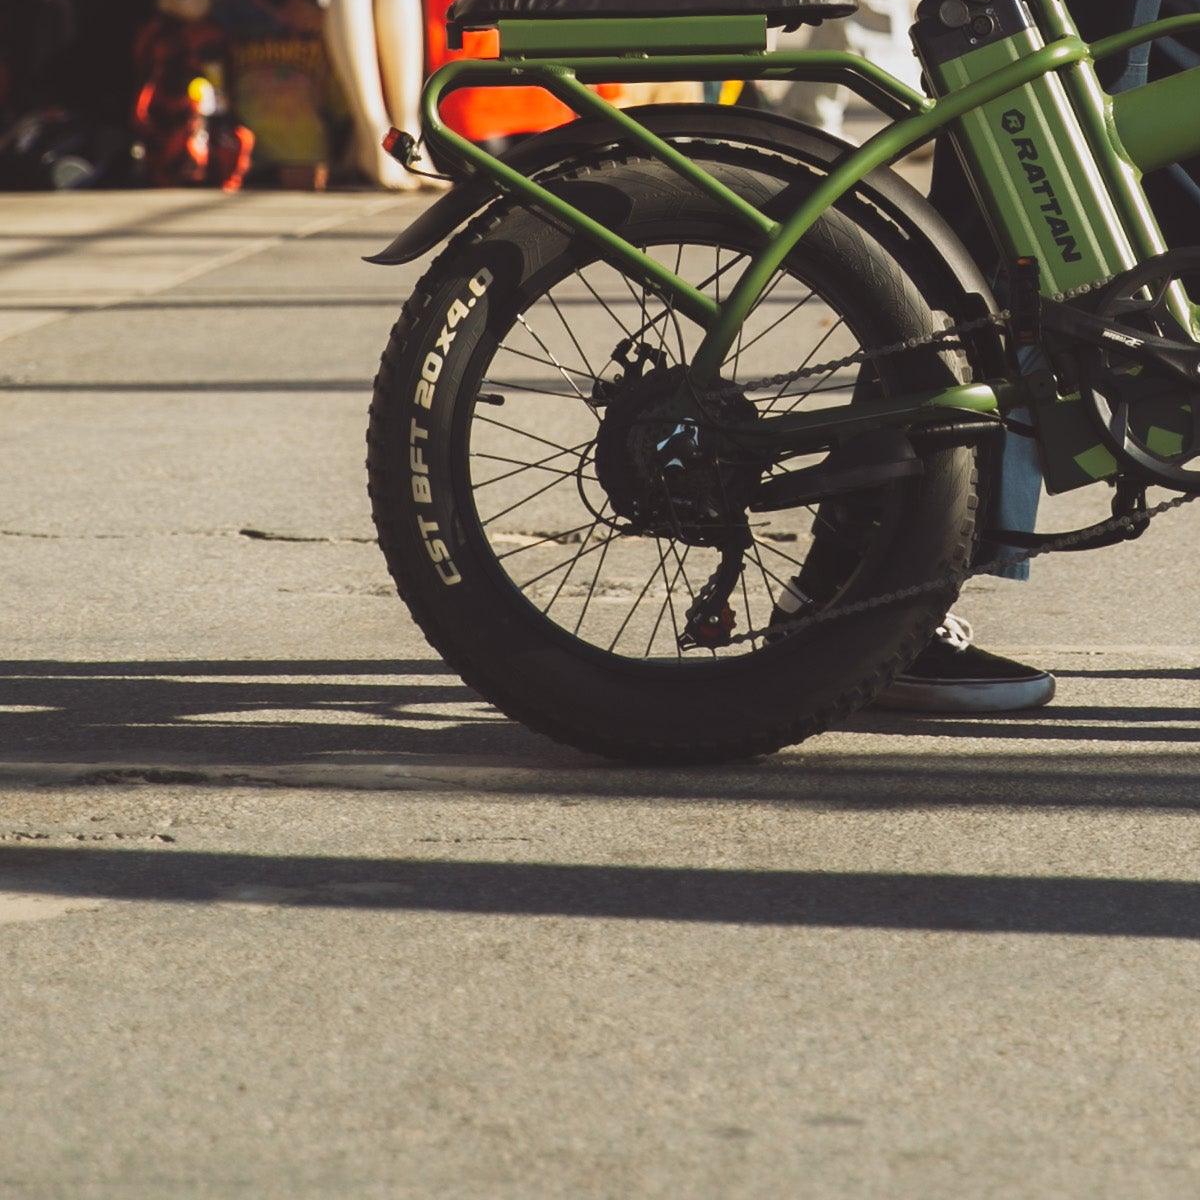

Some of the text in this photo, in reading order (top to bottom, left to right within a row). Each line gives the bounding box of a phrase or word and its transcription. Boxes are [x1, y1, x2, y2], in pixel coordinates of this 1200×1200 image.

[1011, 138, 1082, 262] RATTAN
[409, 418, 432, 503] BFT
[417, 514, 461, 585] CST
